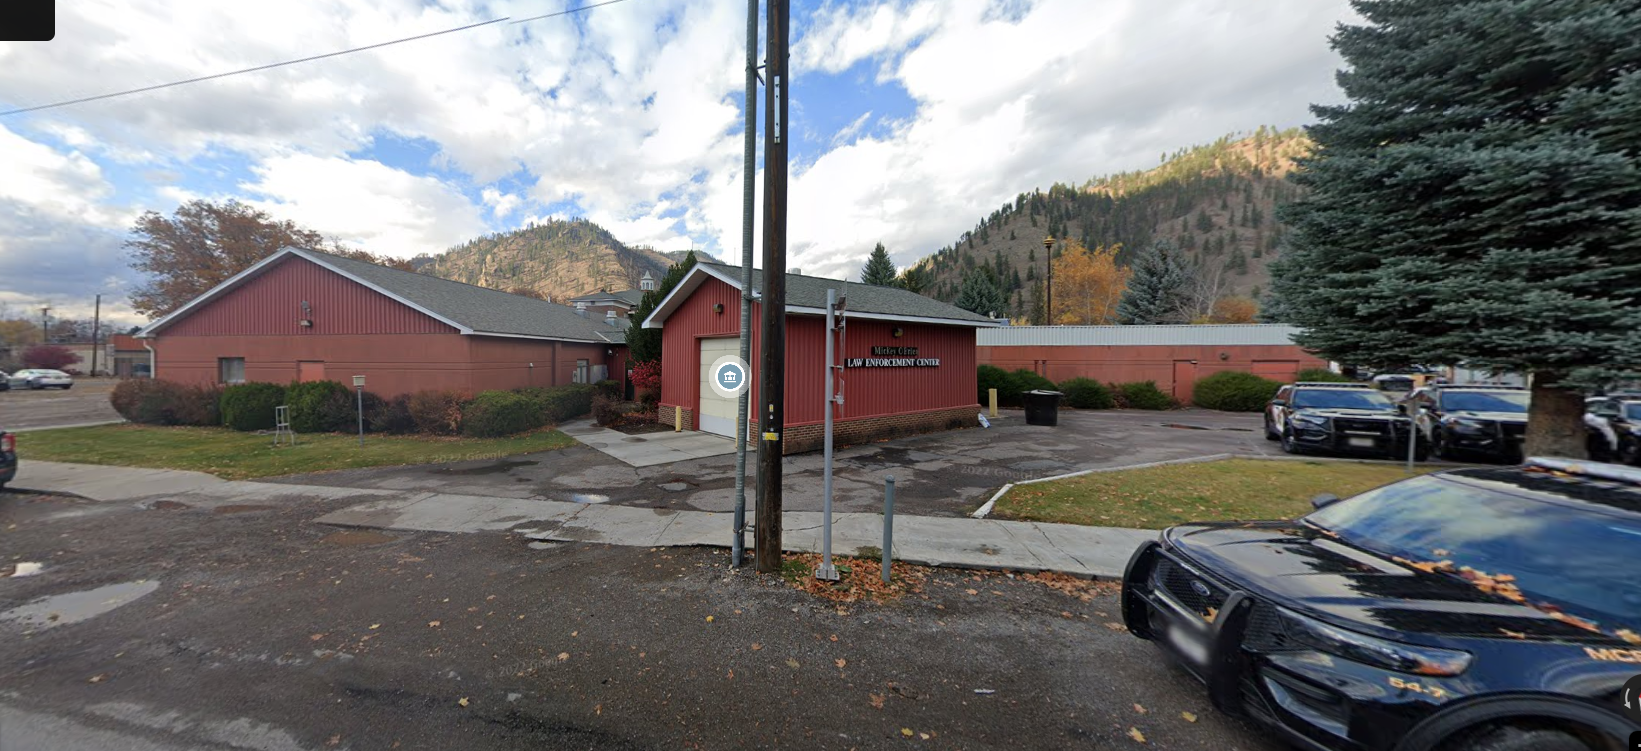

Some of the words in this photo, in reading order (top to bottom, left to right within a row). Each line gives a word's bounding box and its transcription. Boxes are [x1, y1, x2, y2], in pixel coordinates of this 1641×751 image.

[847, 357, 864, 367] LAW
[865, 357, 916, 367] ENFORCEMENT
[916, 357, 941, 367] CENTER
